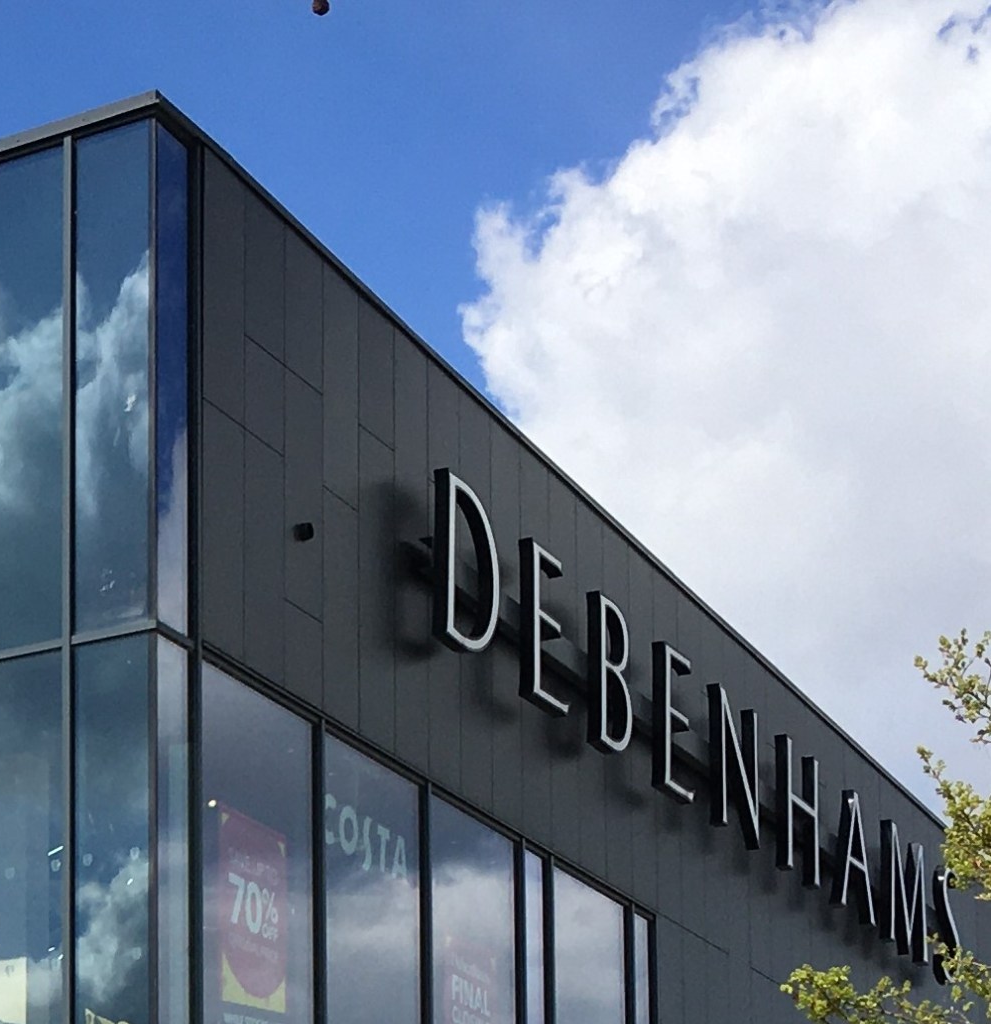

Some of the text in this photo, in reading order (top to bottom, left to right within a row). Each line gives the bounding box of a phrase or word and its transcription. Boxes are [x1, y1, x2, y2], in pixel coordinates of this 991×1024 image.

[432, 467, 962, 986] DEBENHAMS
[324, 793, 409, 885] COSTA
[228, 871, 279, 935] 70%
[451, 973, 491, 1017] FINAL
